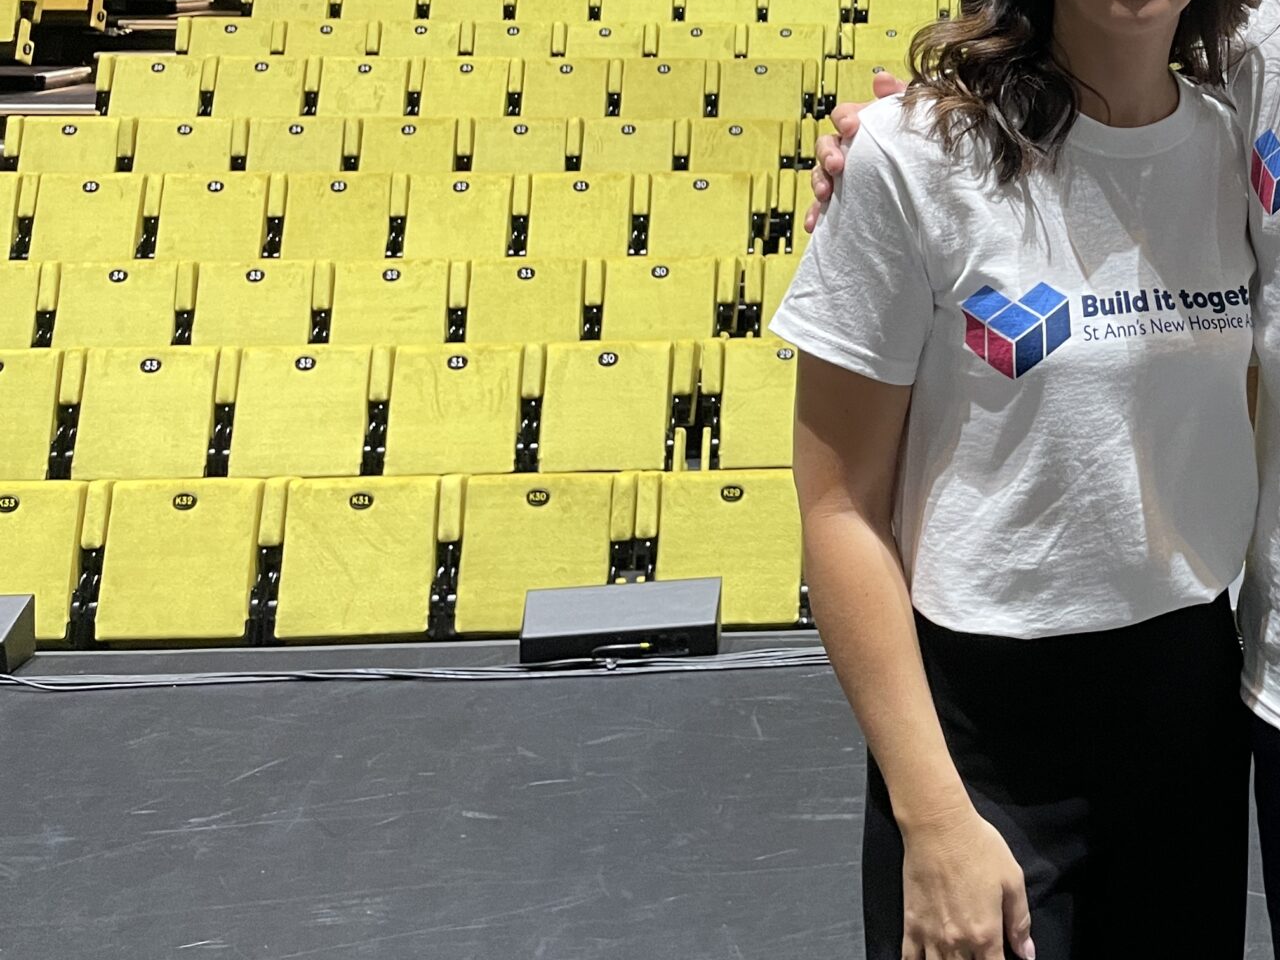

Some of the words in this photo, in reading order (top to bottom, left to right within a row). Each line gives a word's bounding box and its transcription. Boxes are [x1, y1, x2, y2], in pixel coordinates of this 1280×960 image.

[1081, 289, 1149, 318] Build
[1153, 288, 1176, 311] it
[1083, 324, 1100, 341] St
[1104, 319, 1147, 339] Ann's
[1150, 318, 1185, 335] New
[1188, 313, 1244, 333] Hospice
[601, 353, 616, 364] 30
[779, 349, 792, 359] 29
[143, 360, 158, 371] 33
[298, 357, 313, 369] 32
[450, 356, 464, 368] 31
[528, 491, 547, 502] K30
[722, 487, 741, 497] K29
[175, 495, 194, 506] K32
[351, 495, 370, 505] K31
